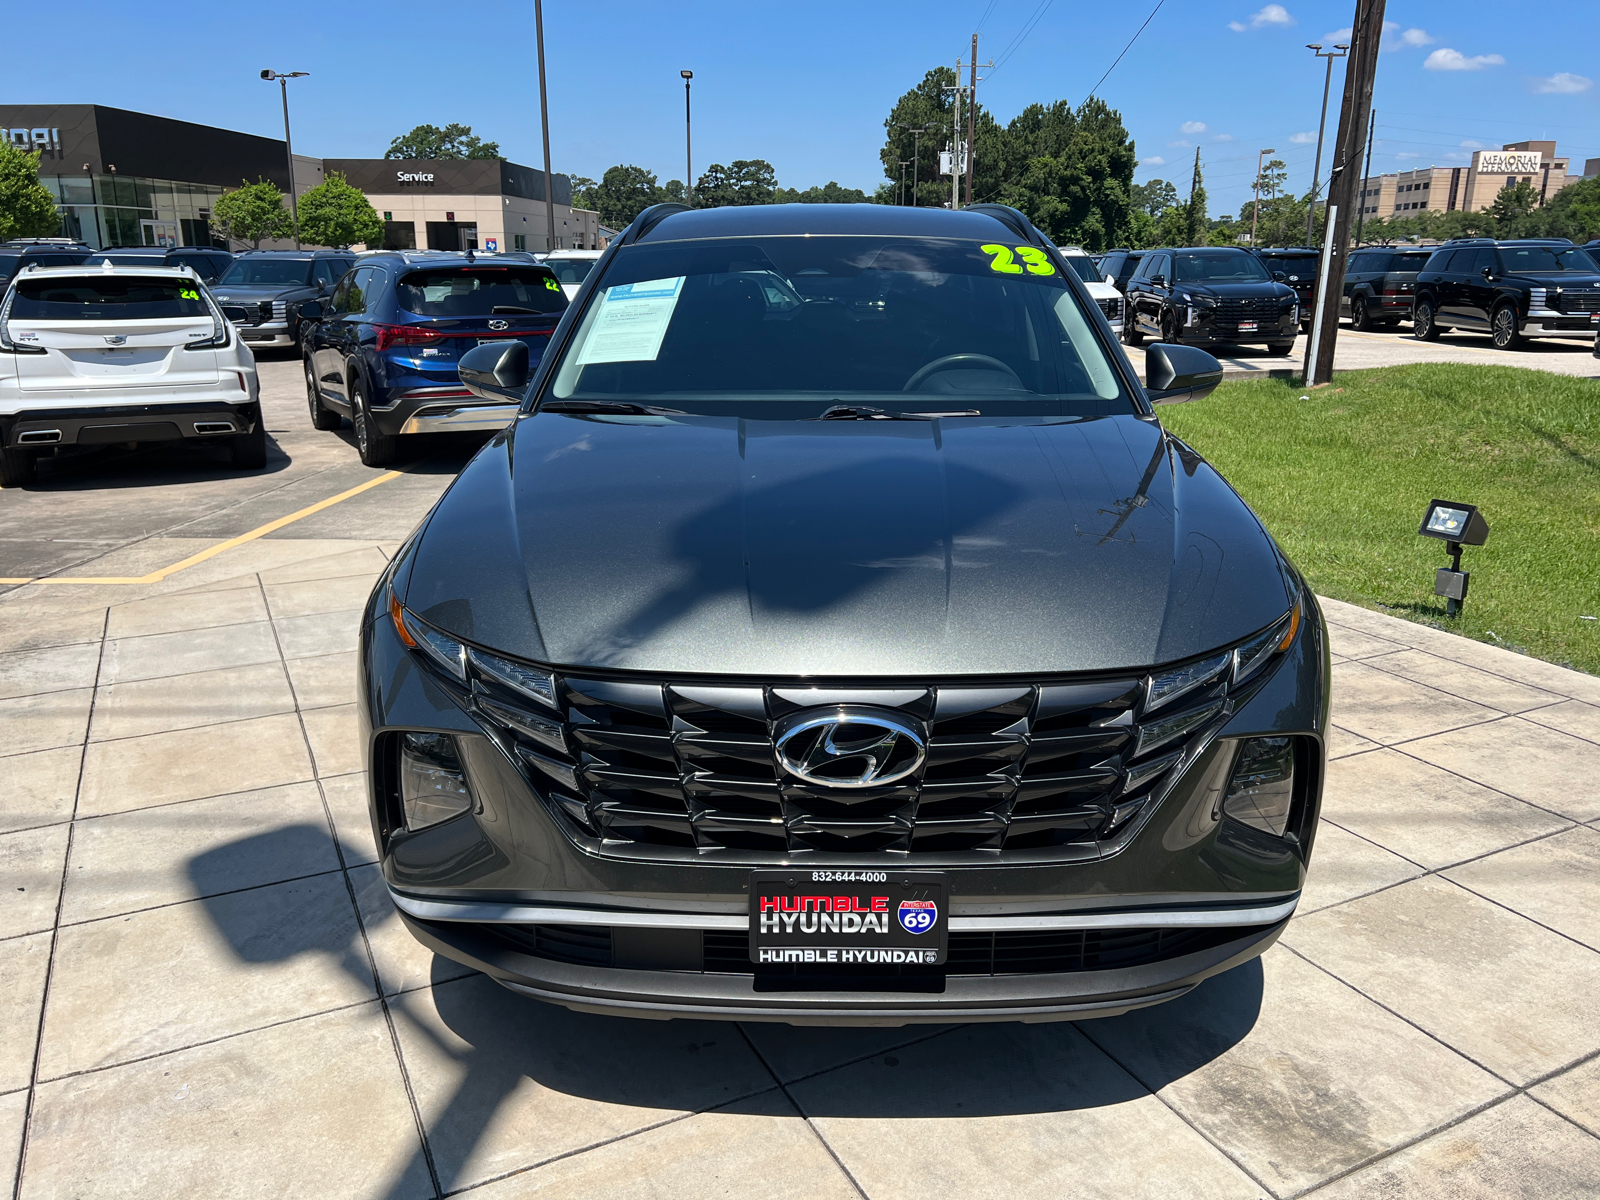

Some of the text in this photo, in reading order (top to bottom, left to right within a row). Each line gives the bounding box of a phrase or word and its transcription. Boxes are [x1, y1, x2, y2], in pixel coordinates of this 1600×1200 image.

[1482, 155, 1538, 164] MEMORIAL
[1481, 163, 1537, 172] HERMANN
[397, 171, 434, 182] Service
[980, 244, 1055, 276] 23
[543, 277, 560, 292] 22
[179, 288, 199, 300] 24
[812, 871, 887, 882] 832-644-4000
[760, 896, 889, 912] HUMBLE
[760, 912, 889, 934] HYUNDAI
[904, 912, 931, 928] 69
[759, 950, 923, 963] HUMBLE HYUNDAI
